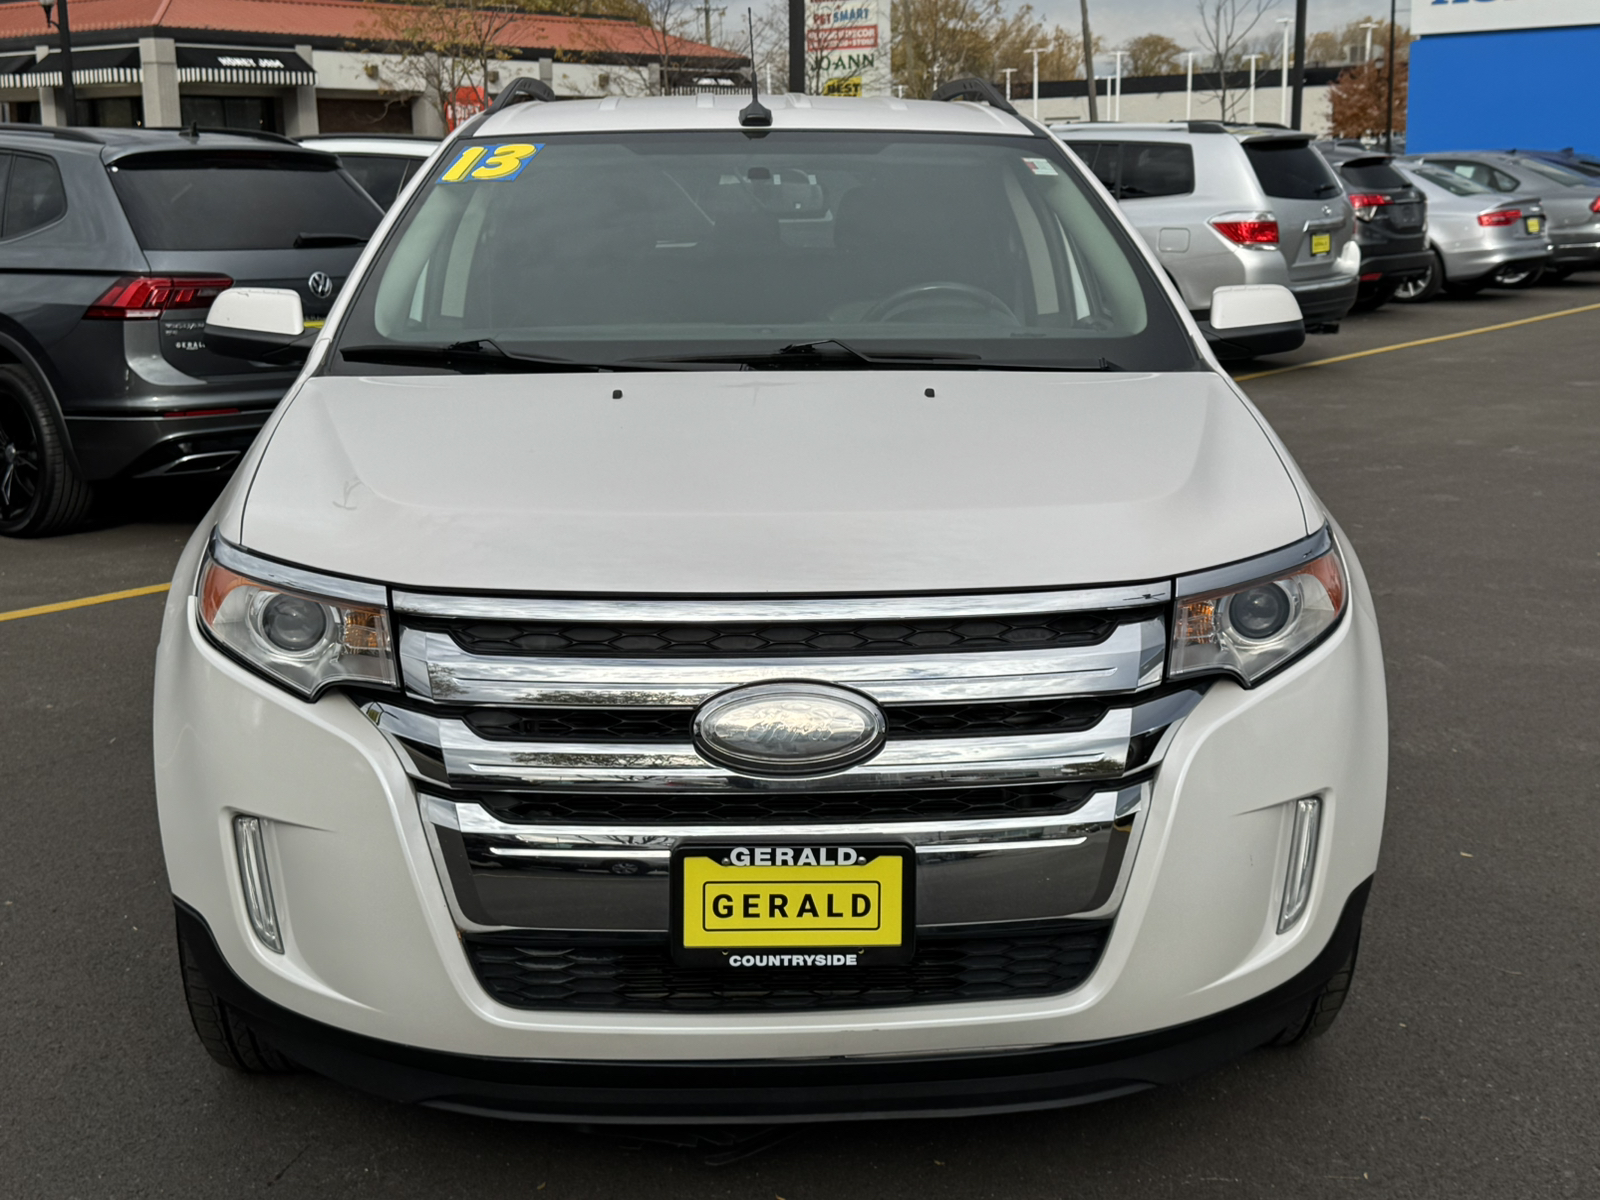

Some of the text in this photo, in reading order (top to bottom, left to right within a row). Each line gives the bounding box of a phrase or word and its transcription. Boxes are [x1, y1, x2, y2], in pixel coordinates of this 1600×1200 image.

[441, 143, 537, 182] 13
[730, 847, 858, 866] GERALD
[712, 894, 872, 918] GERALD
[729, 954, 858, 967] COUNTRYSIDE
